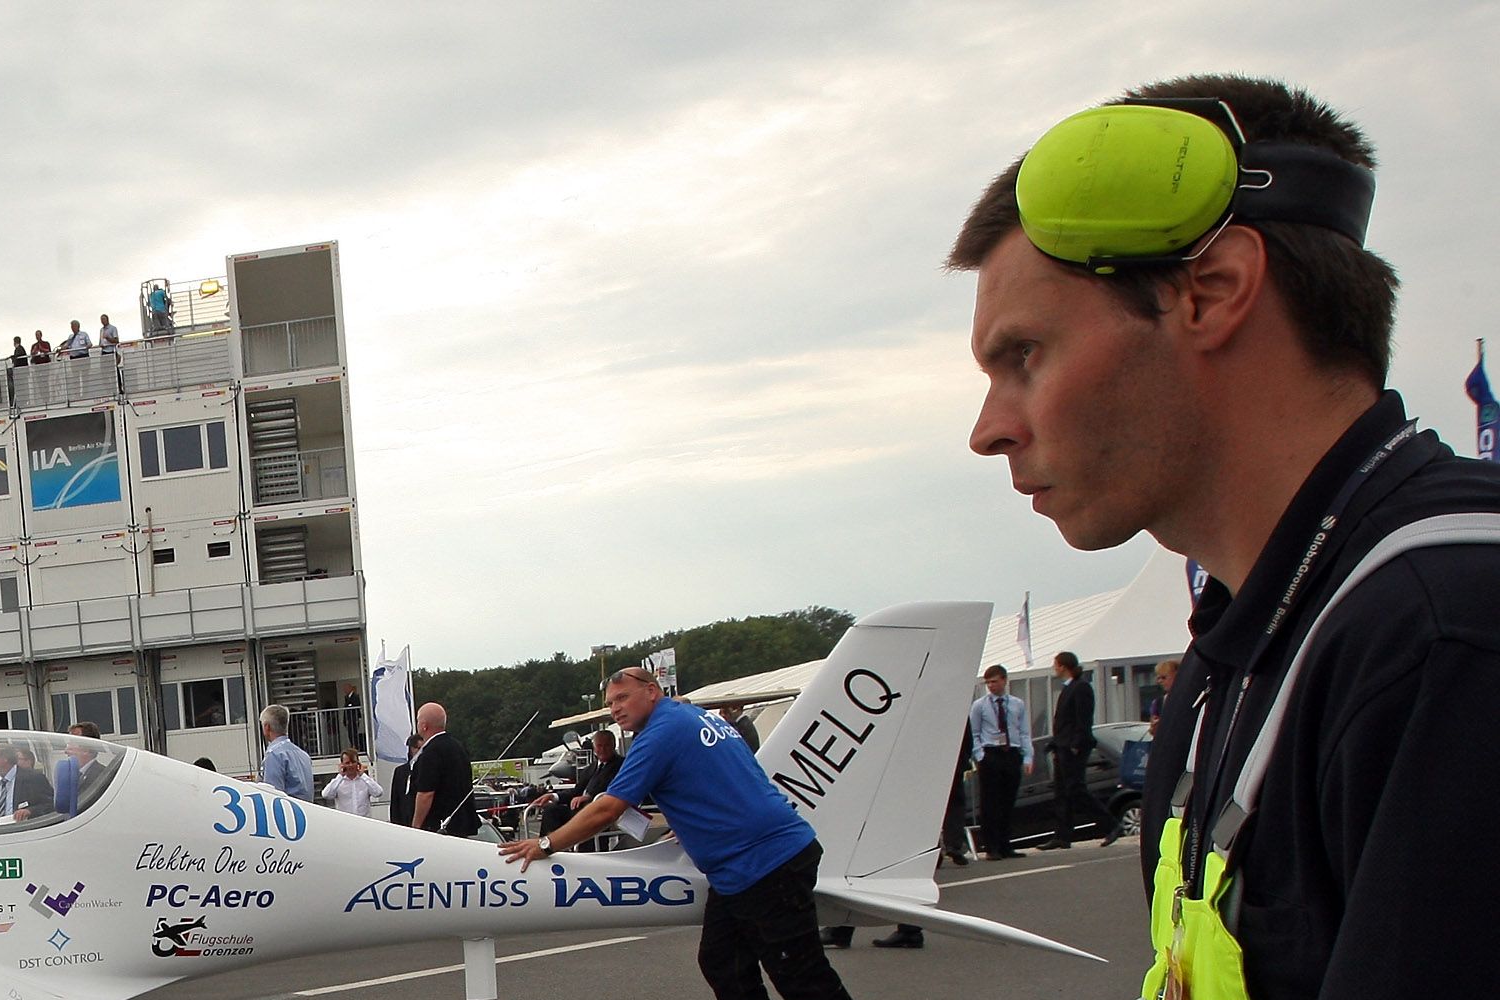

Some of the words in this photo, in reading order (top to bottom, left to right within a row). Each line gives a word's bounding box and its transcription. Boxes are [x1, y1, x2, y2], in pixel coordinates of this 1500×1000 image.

[1282, 532, 1327, 606] GlobeGround
[1265, 606, 1286, 636] Berlin
[771, 668, 902, 810] MELQ
[212, 785, 307, 842] 310
[136, 842, 206, 873] Elektra
[214, 845, 248, 875] One
[255, 847, 304, 876] Solar
[145, 884, 276, 909] PC-Aero
[190, 932, 254, 947] Flugschule
[19, 957, 42, 969] DST
[45, 951, 104, 967] CONTROL
